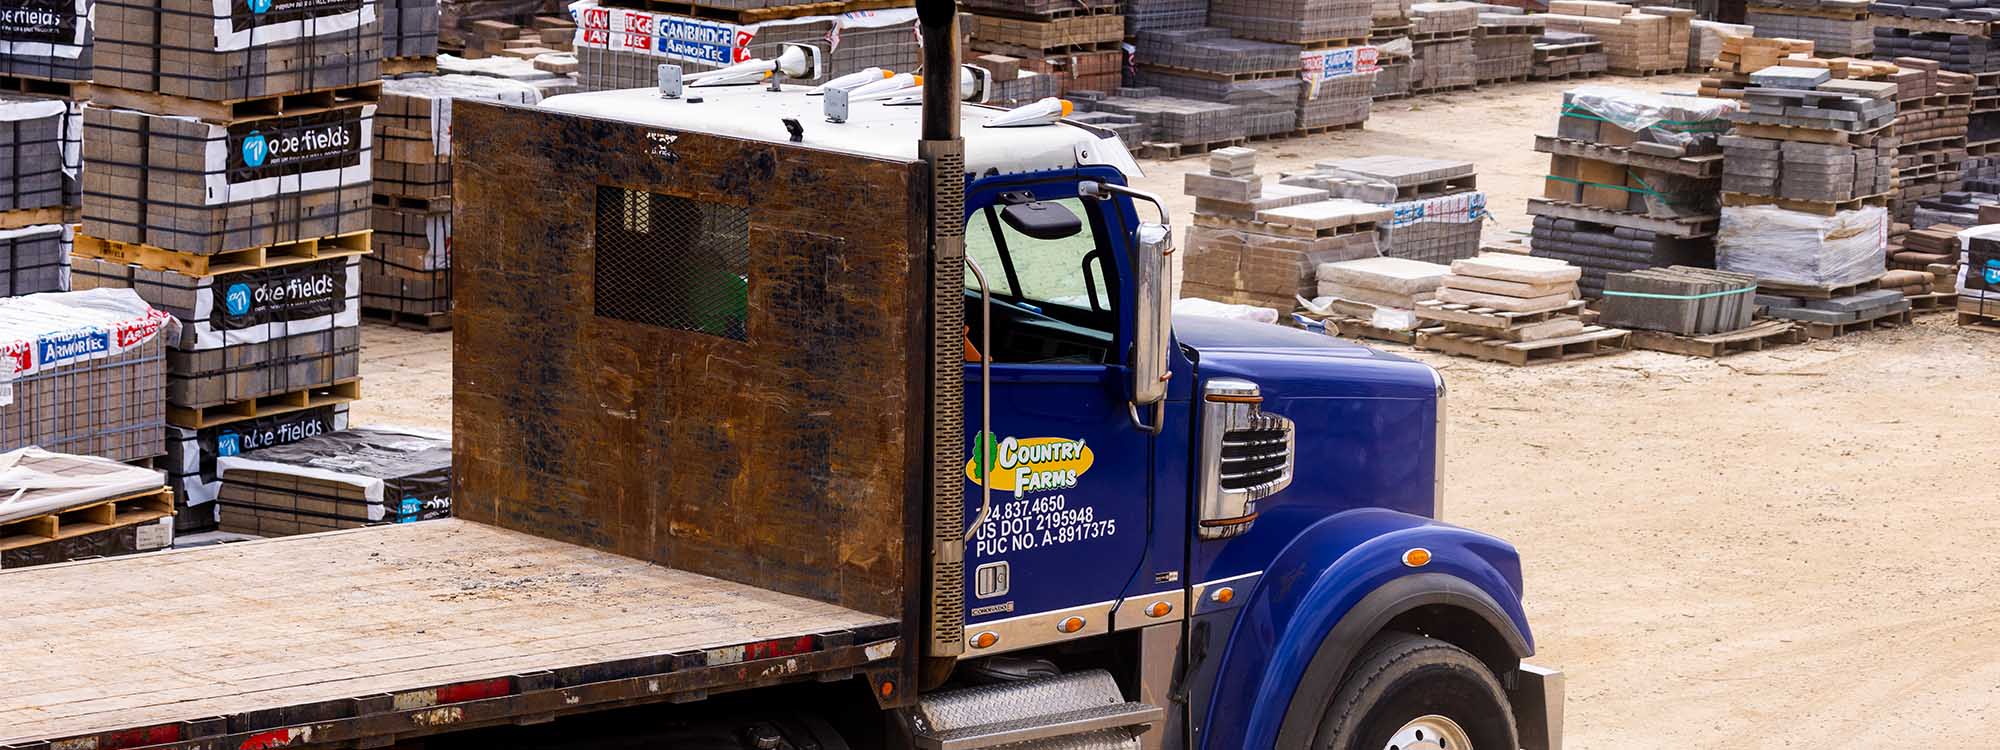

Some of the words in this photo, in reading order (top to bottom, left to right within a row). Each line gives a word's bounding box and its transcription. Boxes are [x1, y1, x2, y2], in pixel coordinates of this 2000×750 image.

[660, 21, 731, 45] CAMBRIDGE
[976, 523, 997, 541] US
[1001, 516, 1032, 537] DOT
[1036, 507, 1094, 531] 2195948
[976, 537, 1008, 558] PUC
[1012, 532, 1038, 551] NO.
[1042, 520, 1116, 547] A-8917375
